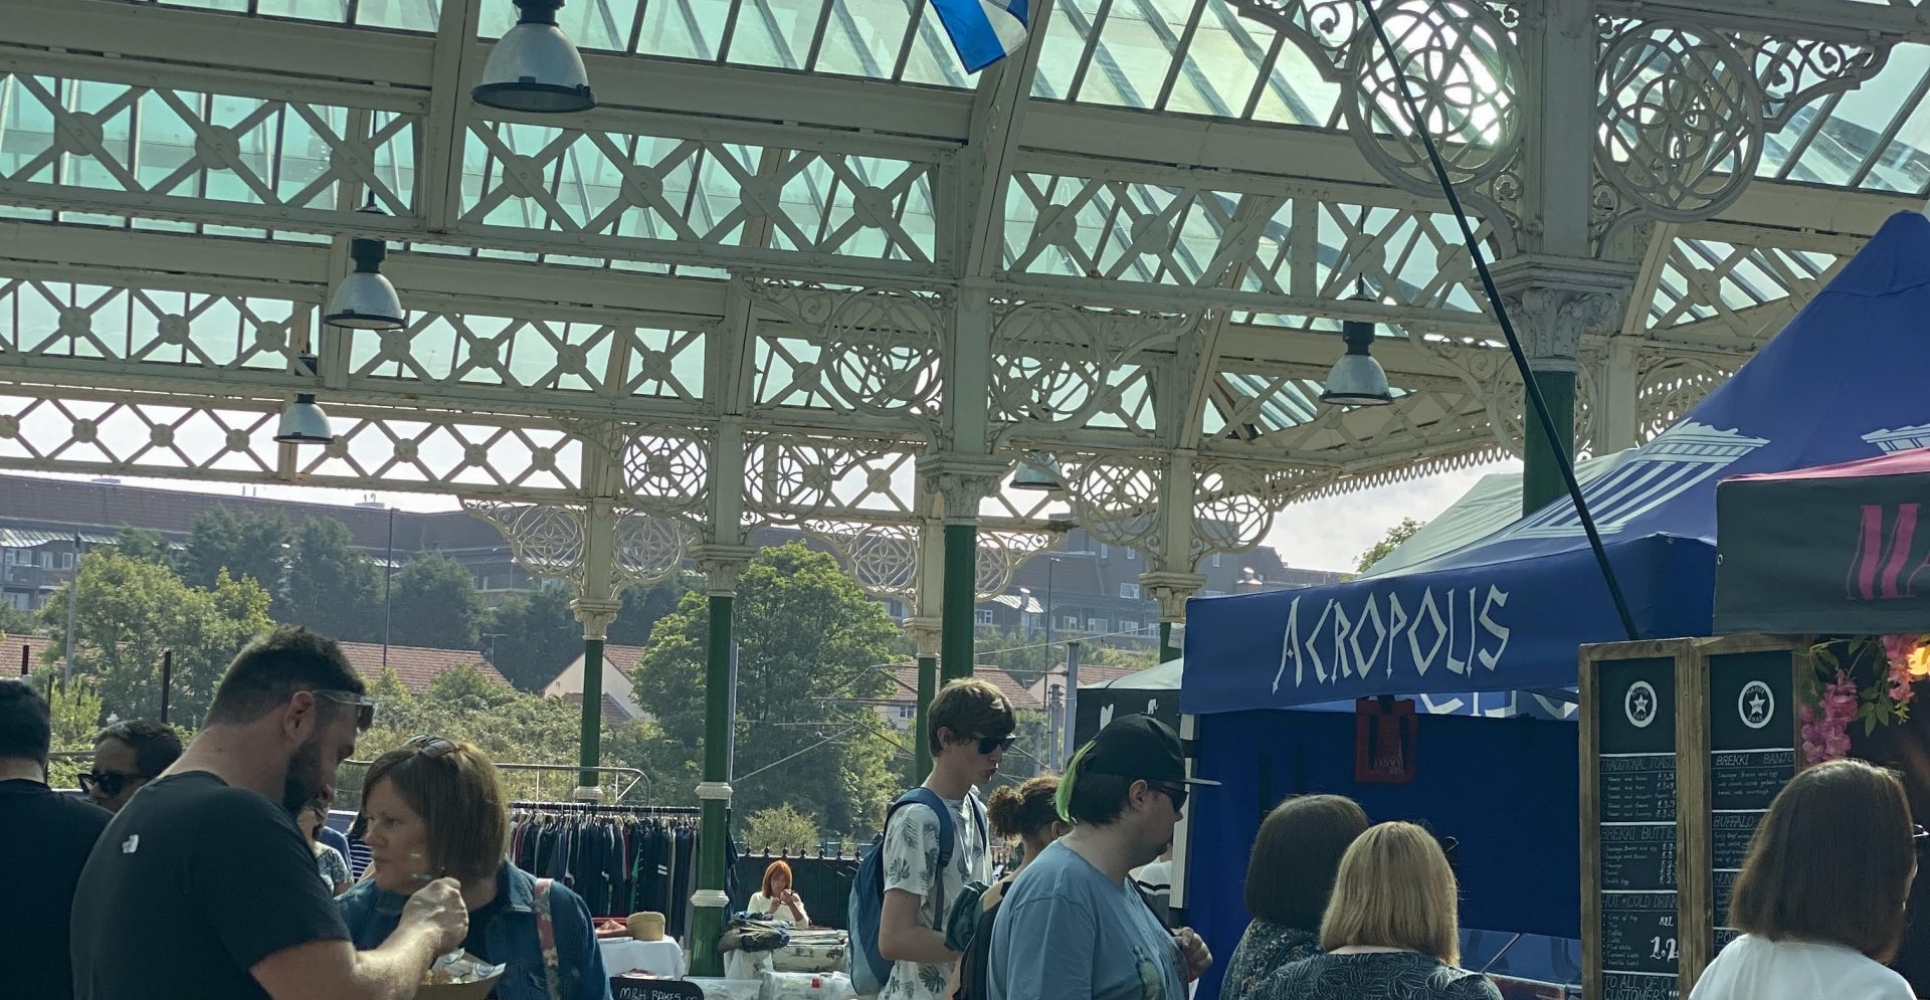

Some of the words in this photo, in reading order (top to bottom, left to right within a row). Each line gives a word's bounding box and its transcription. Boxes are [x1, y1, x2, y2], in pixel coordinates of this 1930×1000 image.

[1272, 583, 1510, 695] ACROPOLIS
[1716, 753, 1750, 766] BREKKI
[1713, 815, 1755, 828] BUFFALO
[1601, 826, 1636, 839] BREKKI
[1627, 895, 1651, 908] COLD
[1659, 916, 1675, 927] ALL
[1604, 975, 1617, 988] TO
[1619, 975, 1640, 989] ALL
[1644, 976, 1659, 990] OF
